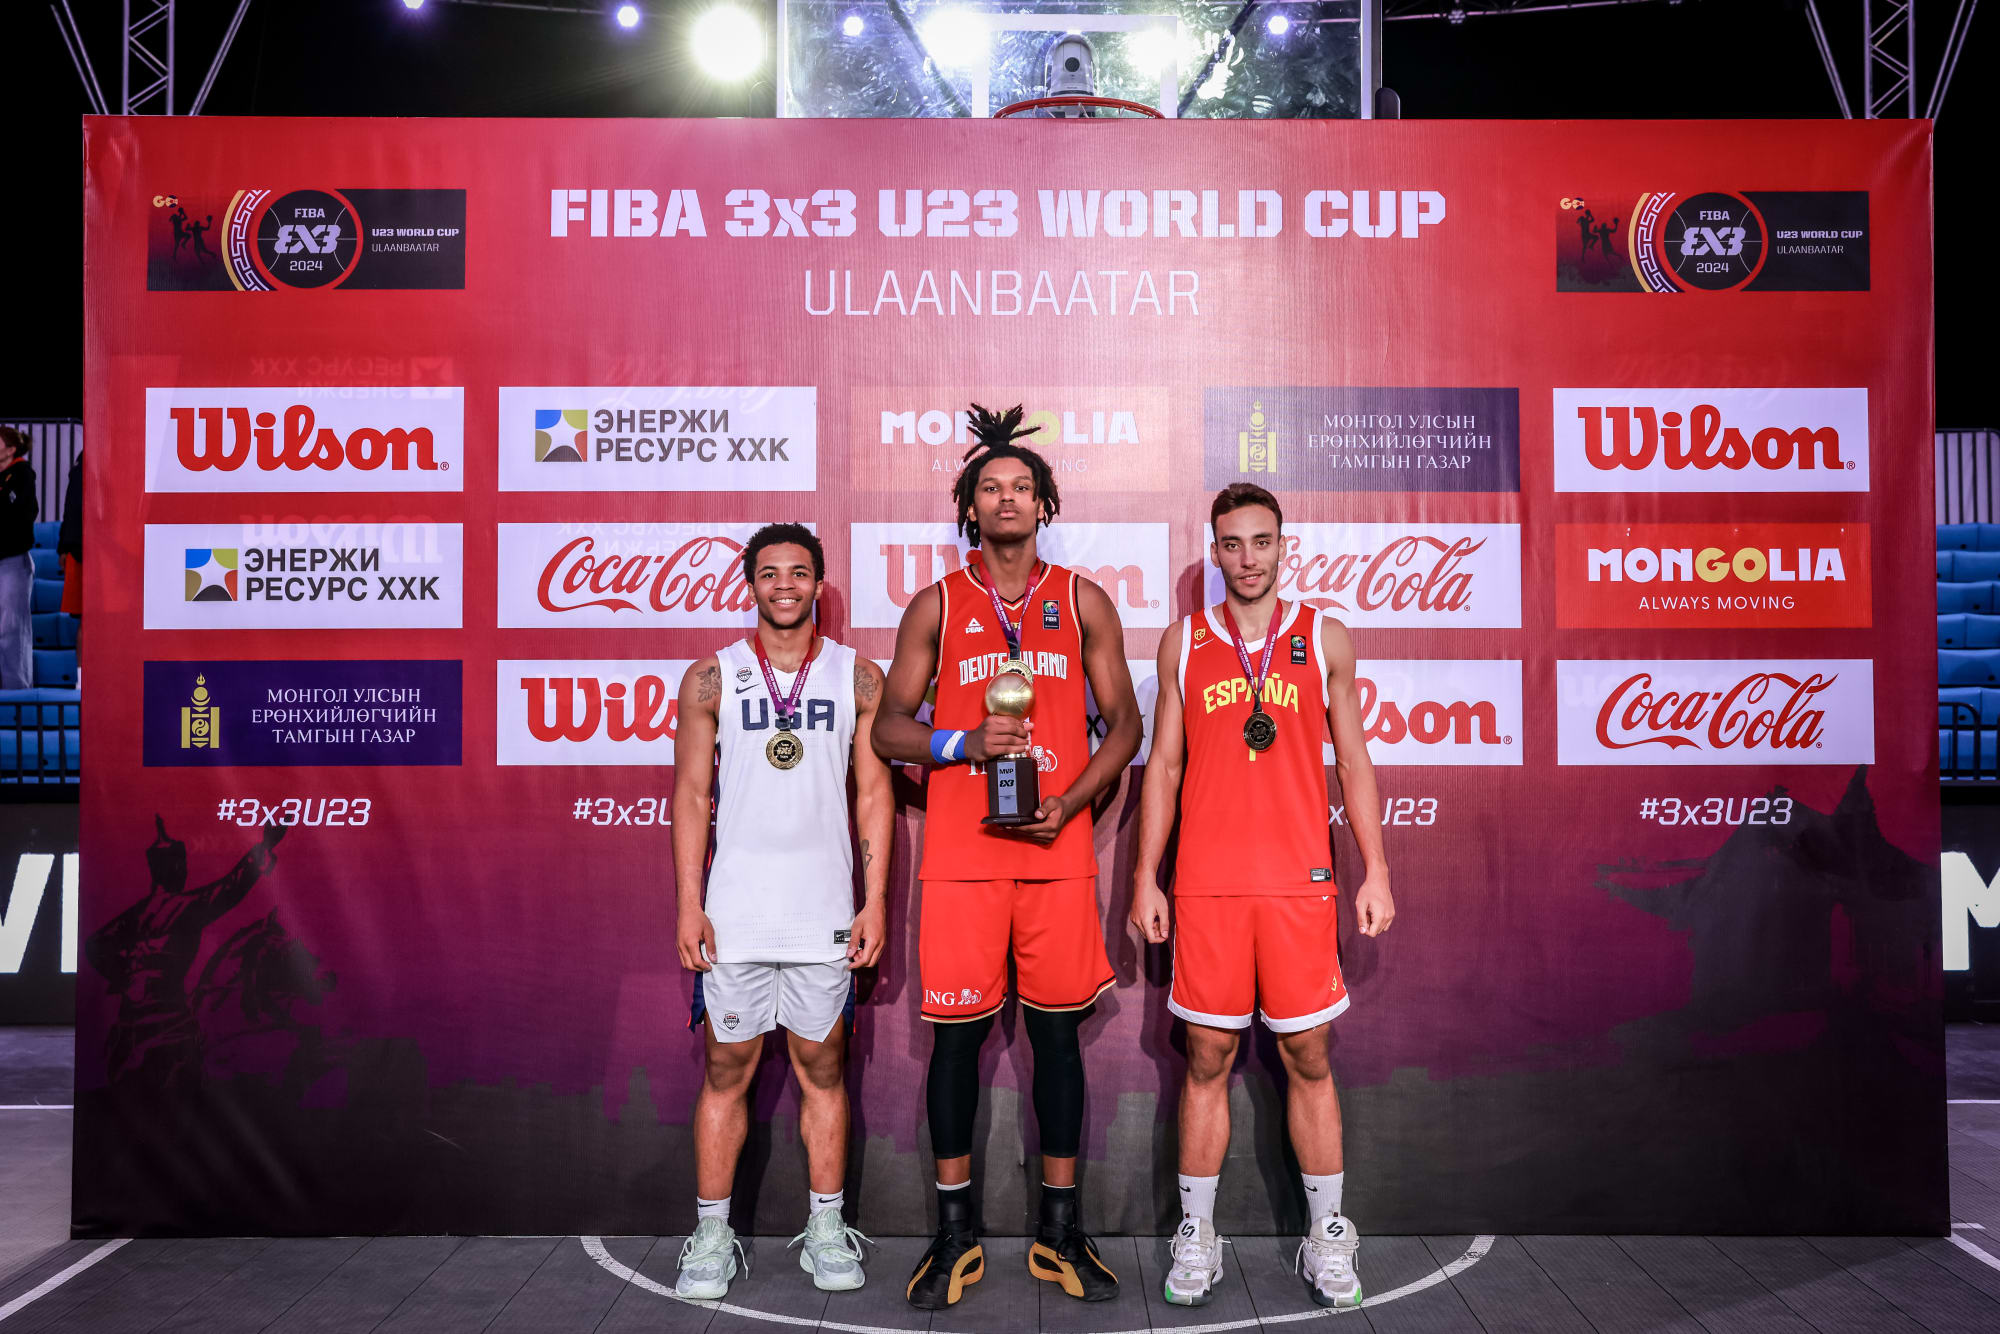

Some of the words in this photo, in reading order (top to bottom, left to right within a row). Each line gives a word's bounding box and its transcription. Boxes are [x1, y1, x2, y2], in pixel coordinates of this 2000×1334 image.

[294, 208, 326, 219] FIBA
[550, 189, 707, 238] FIBA
[725, 189, 857, 238] 3x3
[878, 189, 1019, 238] U23
[1037, 189, 1283, 238] WORLD
[1304, 189, 1446, 239] CUP
[1699, 210, 1730, 221] FIBA
[372, 228, 394, 237] U23
[396, 228, 435, 237] WORLD
[437, 228, 459, 237] CUP
[1776, 230, 1798, 240] U23
[1800, 230, 1839, 240] WORLD
[1841, 230, 1863, 240] CUP
[371, 243, 439, 253] ULAANBAATAR
[1776, 245, 1844, 255] ULAANBAATAR
[289, 260, 324, 271] 2024
[1696, 262, 1729, 273] 2024
[804, 269, 1200, 316] ULAANBAATAR
[594, 409, 729, 433] ЭНЕРЖИ
[1323, 414, 1403, 429] МОНГОЛ
[1408, 414, 1476, 430] УЛСЫН
[170, 404, 438, 472] Wilson
[1308, 432, 1492, 450] ЕРӨНХИЙЛӨГЧИЙН
[1577, 404, 1845, 471] Wilson
[596, 437, 717, 463] РЕСУРС
[727, 437, 790, 462] ХХК
[1328, 454, 1411, 469] ТАМГЫН
[1416, 455, 1472, 469] ГАЗАР
[244, 548, 380, 573] ЭНЕРЖИ
[1588, 547, 1846, 583] MONGOLIA
[246, 576, 368, 602] РЕСУРС
[377, 576, 440, 601] ХХК
[1638, 596, 1710, 610] ALWAYS
[1717, 596, 1795, 610] MOVING
[965, 625, 985, 634] PEAK
[267, 688, 348, 703] МОНГОЛ
[354, 688, 421, 703] УЛСЫН
[251, 706, 437, 724] ЕРӨНХИЙЛӨГЧИЙН
[1595, 672, 1839, 751] Coca-Cola
[271, 729, 355, 744] ТАМГЫН
[361, 729, 417, 744] ГАЗАР
[217, 798, 372, 827] #3x3U23
[1639, 797, 1793, 826] #3x3U23
[925, 989, 955, 1006] ING
